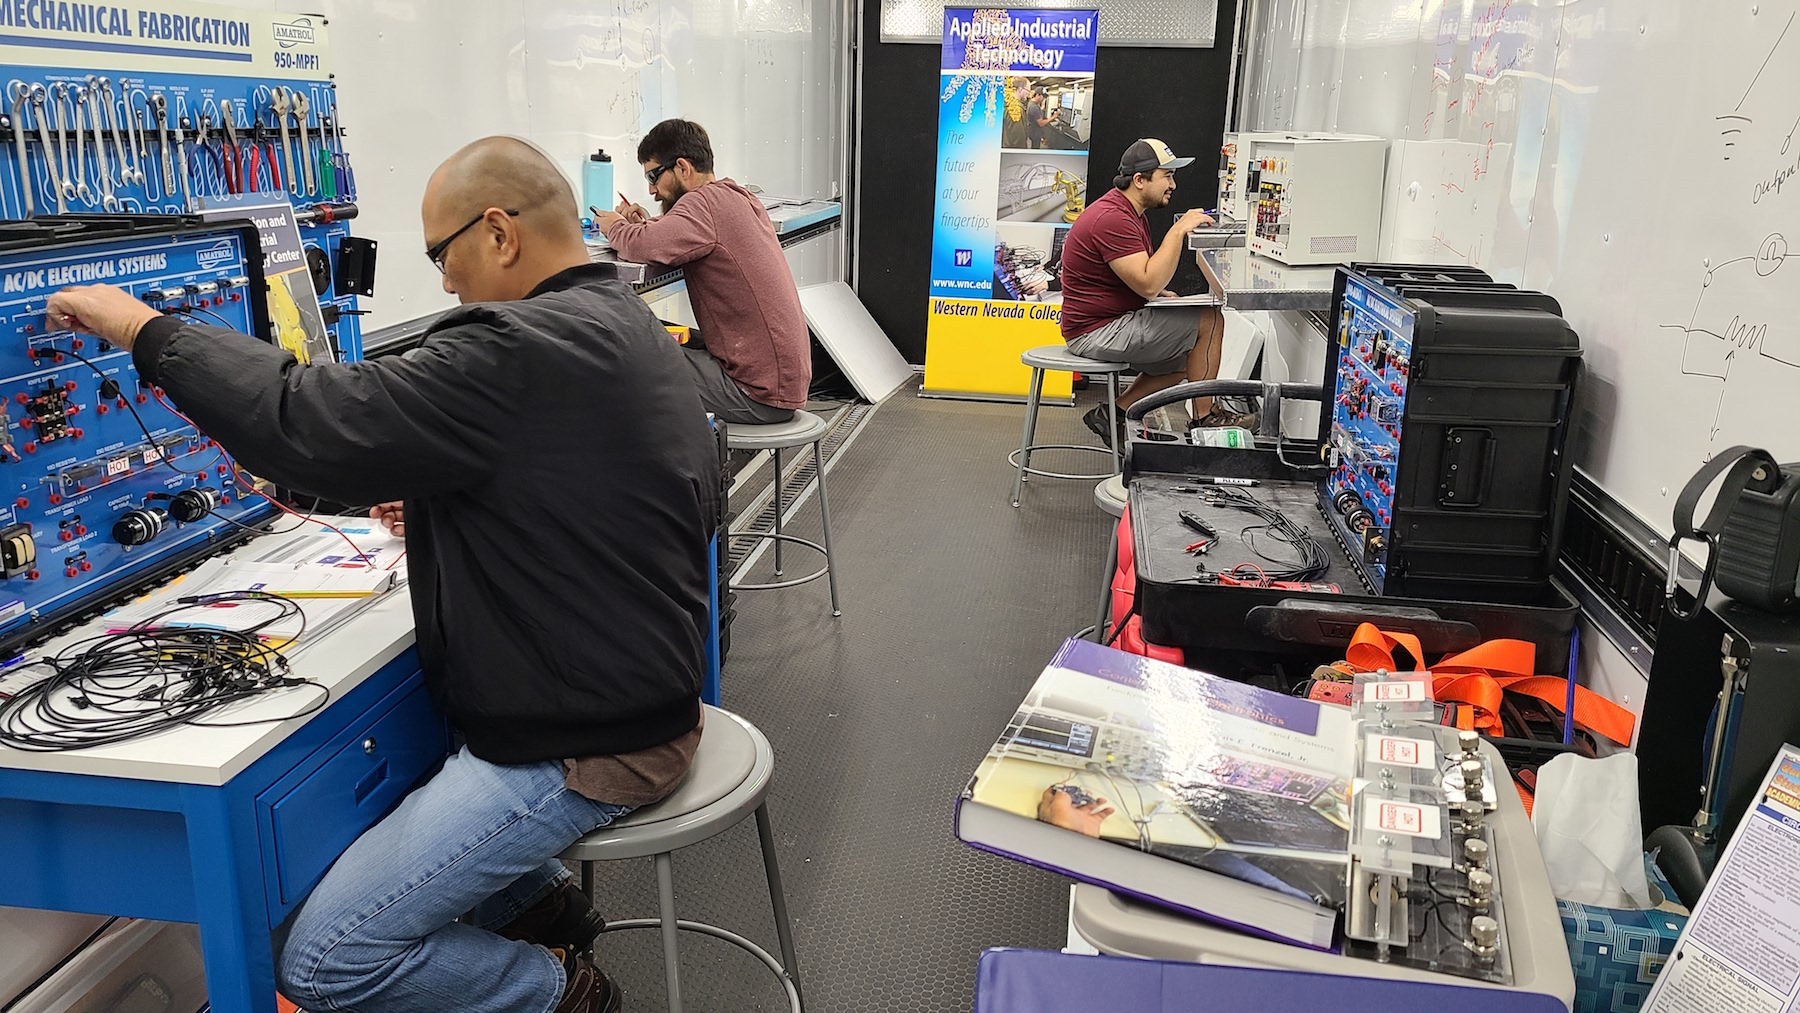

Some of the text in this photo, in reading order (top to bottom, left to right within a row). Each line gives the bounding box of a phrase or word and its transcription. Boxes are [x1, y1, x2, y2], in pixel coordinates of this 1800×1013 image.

[138, 10, 250, 47] FABRICATION
[276, 27, 312, 40] AMATROL
[949, 17, 1092, 40] Applied Industrial
[274, 51, 319, 70] 950-MPF1
[972, 44, 1064, 69] Technology
[946, 129, 965, 145] The
[943, 157, 975, 173] future
[942, 187, 980, 204] at your
[269, 213, 288, 228] and
[941, 212, 990, 231] fingertips
[200, 249, 232, 261] AMATROL
[271, 249, 300, 264] Center
[4, 252, 167, 293] AC/DC ELECTRICAL SYSTEMS
[933, 277, 992, 291] www.wnc.edu
[933, 300, 1062, 324] Western Nevada Colleg
[109, 459, 127, 473] HOT
[1702, 954, 1760, 994] ELECTRICAL SIGNAL
